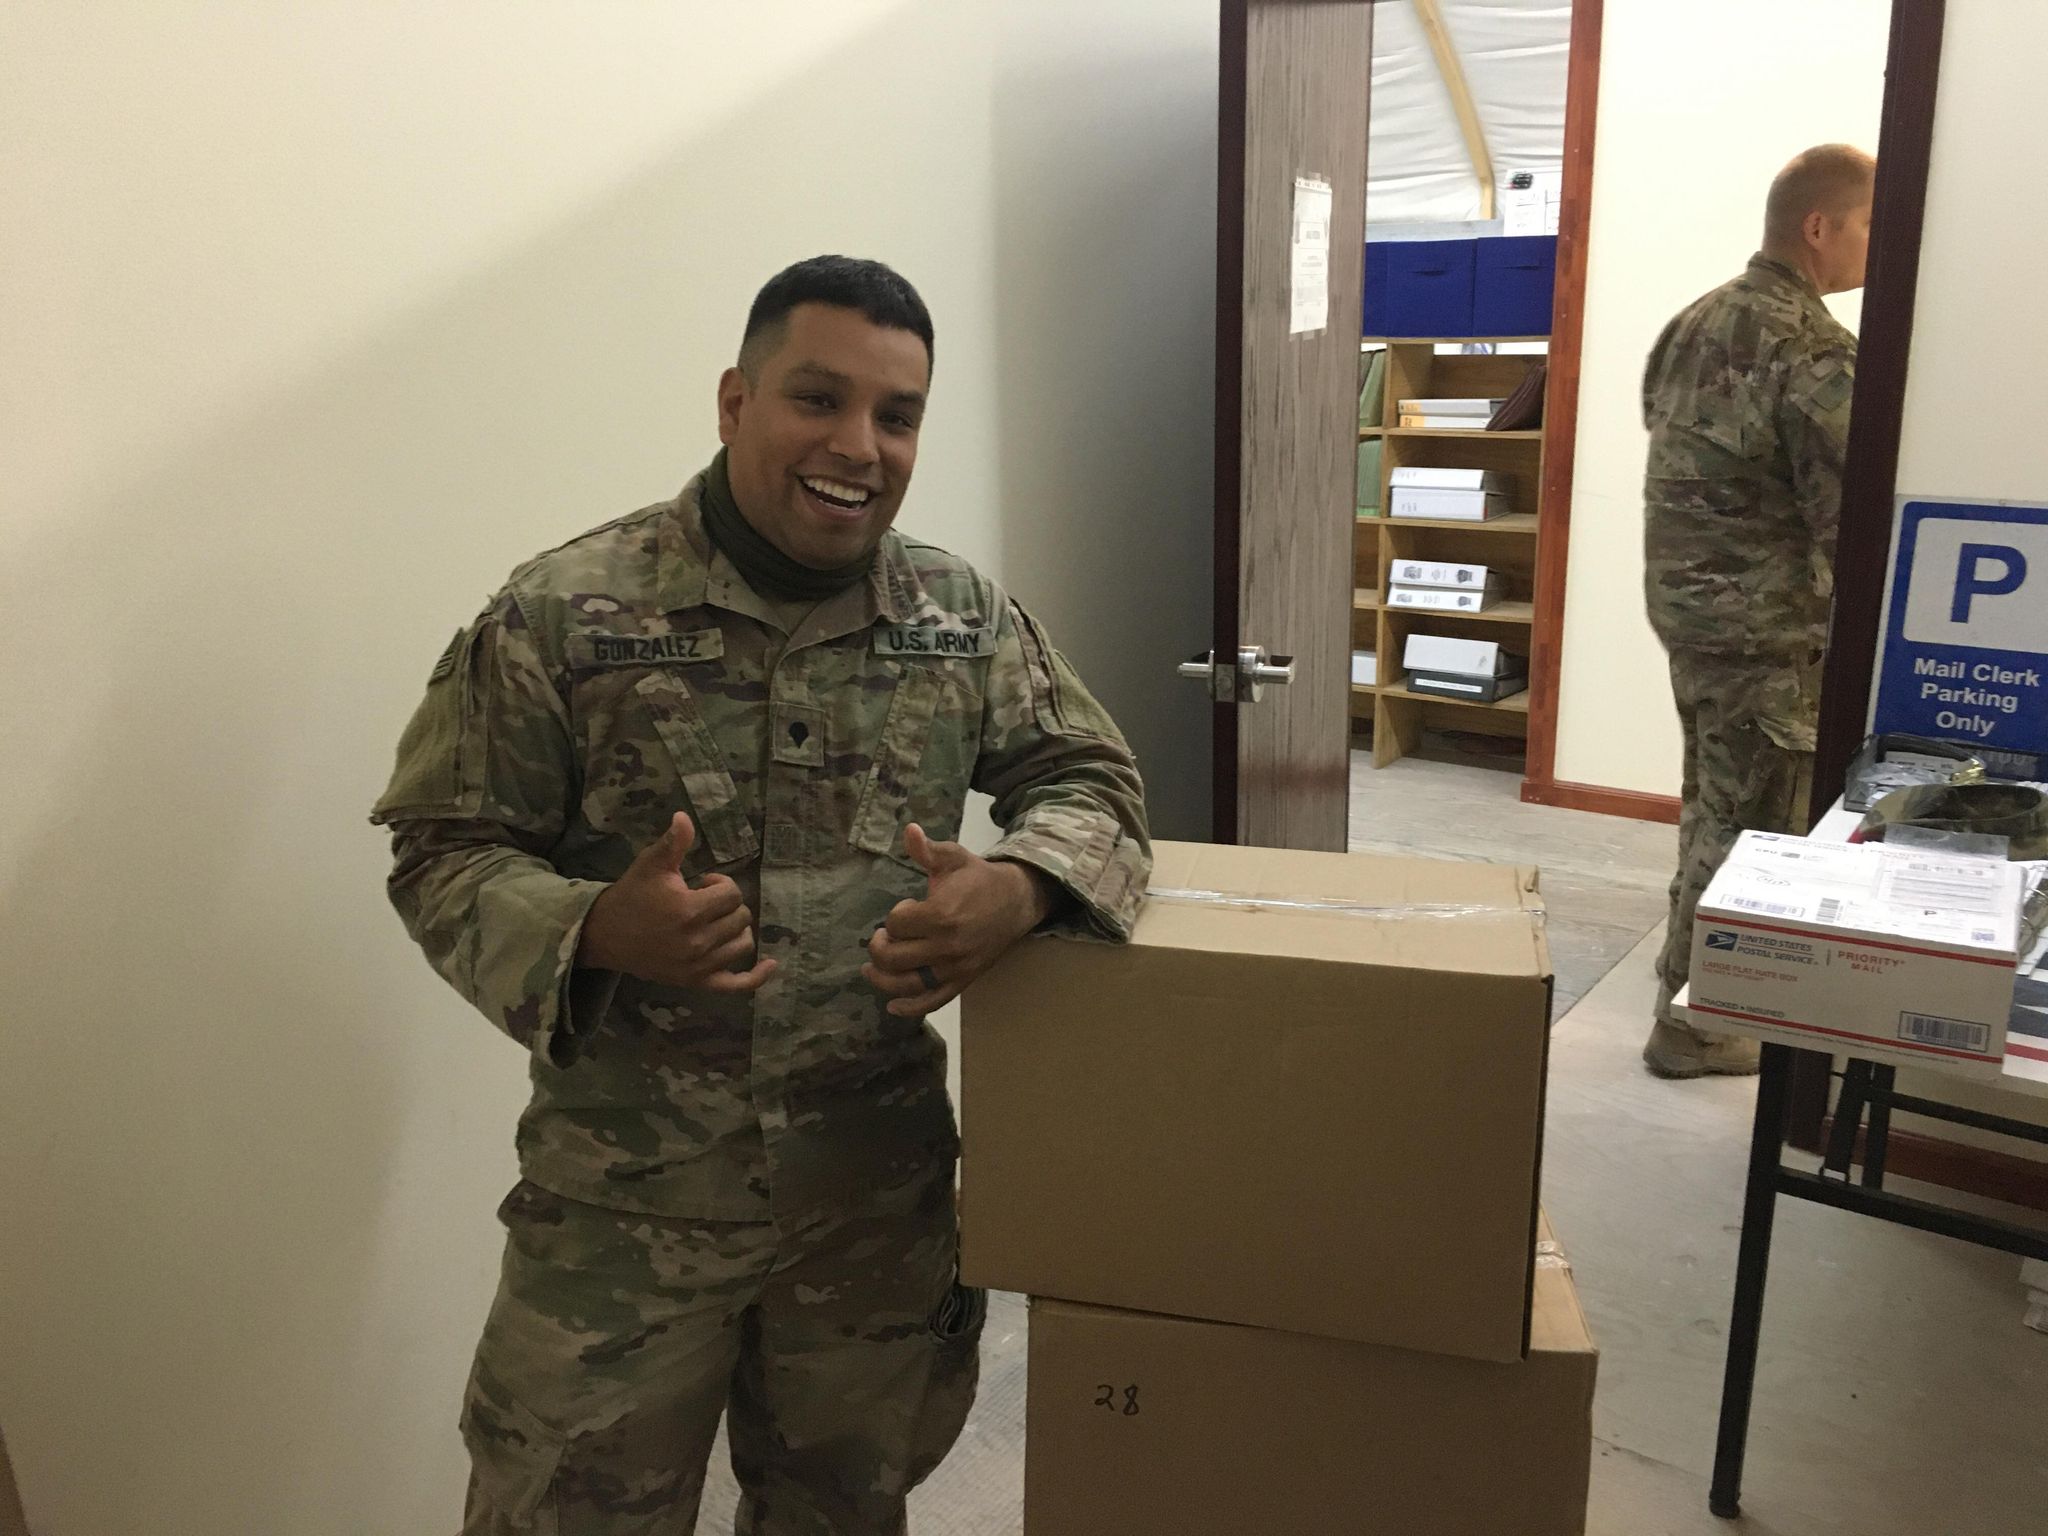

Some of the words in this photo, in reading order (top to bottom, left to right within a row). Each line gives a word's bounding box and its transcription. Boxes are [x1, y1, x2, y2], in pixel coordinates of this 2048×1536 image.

[1950, 542, 2027, 624] P
[594, 634, 702, 662] GONZALEZ
[888, 630, 928, 653] U.S.
[935, 631, 981, 654] ARMY
[1914, 657, 1965, 680] Mail
[1972, 662, 2040, 688] Clerk
[1920, 682, 2019, 713] Parking
[1935, 710, 1996, 738] Only
[1737, 946, 1772, 958] POSTAL
[1774, 952, 1814, 965] SERVICE
[1740, 934, 1778, 945] UNITED
[1779, 940, 1813, 952] STATES
[1837, 949, 1900, 967] PRIORITY
[1851, 962, 1884, 975] MAIL
[1094, 1384, 1140, 1416] 28
